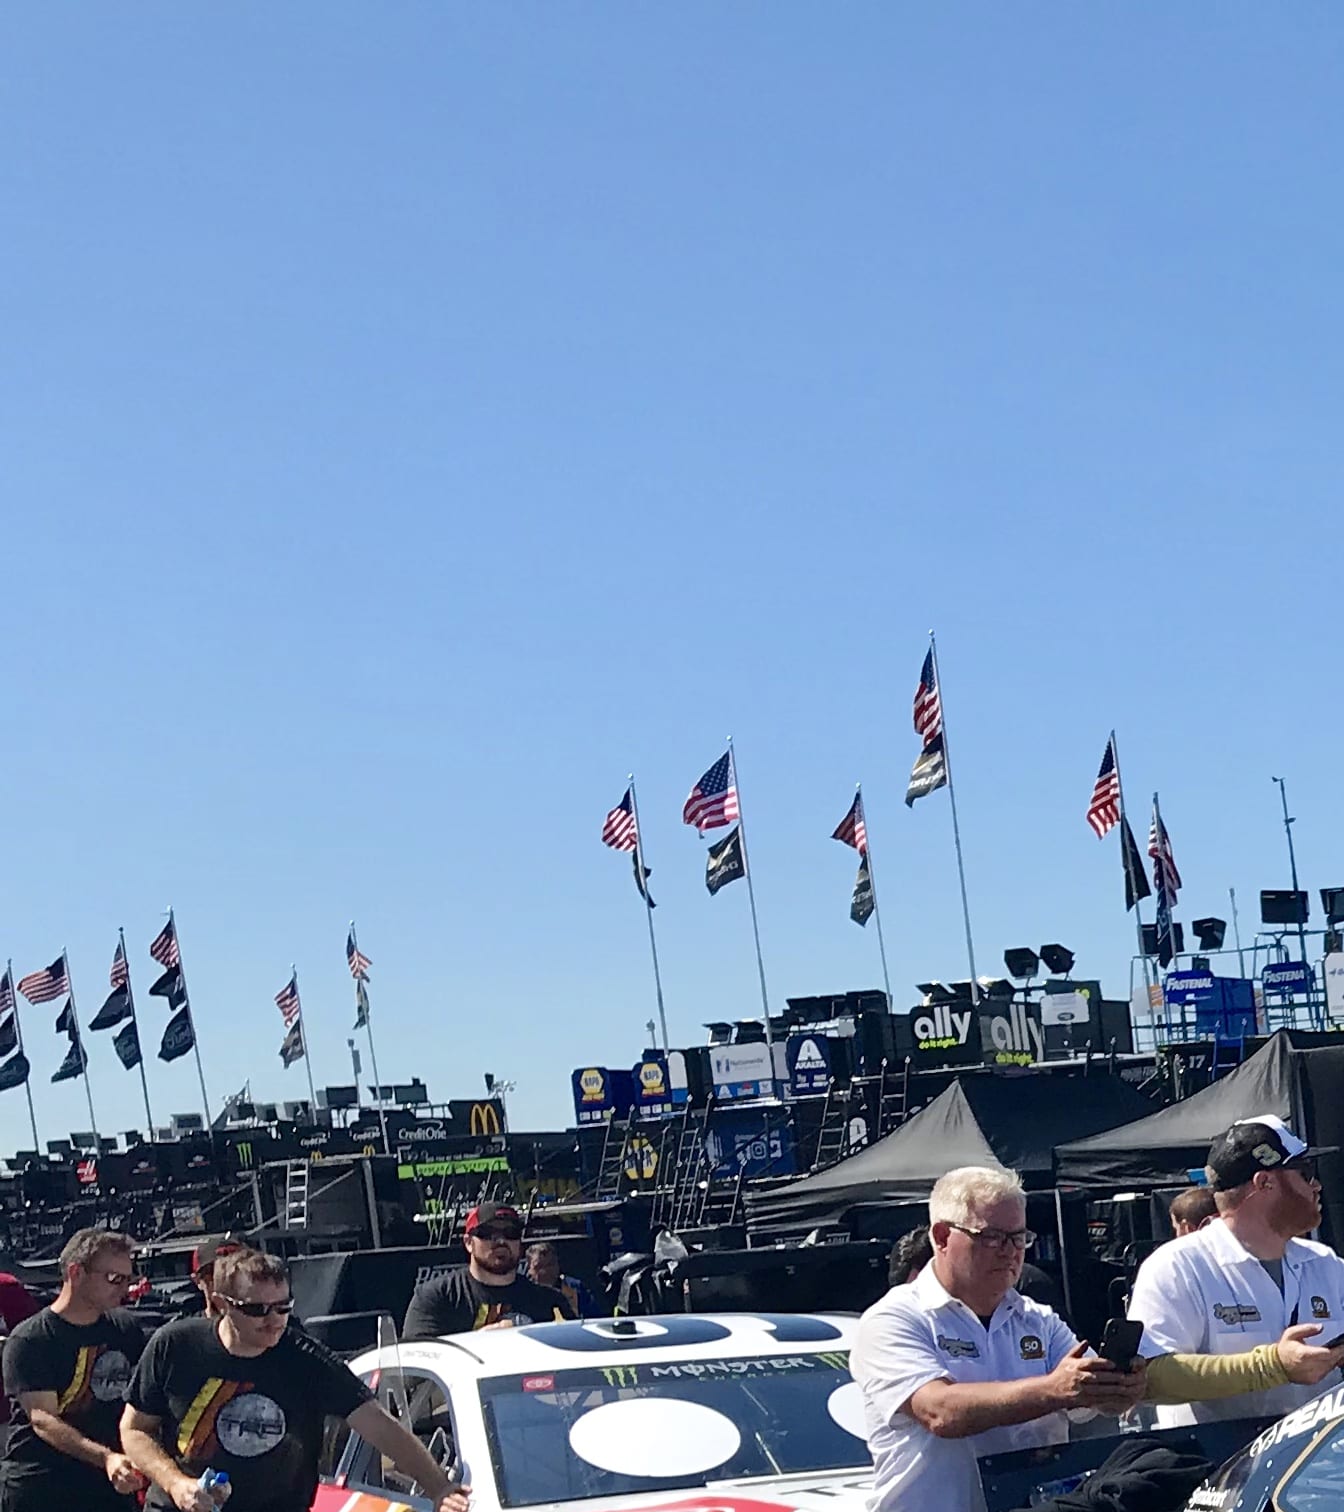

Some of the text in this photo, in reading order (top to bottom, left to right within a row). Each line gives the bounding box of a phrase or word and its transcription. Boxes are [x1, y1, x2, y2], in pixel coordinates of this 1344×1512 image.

[1166, 977, 1214, 992] FASTENAL
[914, 1006, 971, 1044] ally
[990, 1004, 1044, 1064] ally
[795, 1060, 826, 1070] AXALTA
[1188, 1055, 1206, 1069] 17
[1251, 1143, 1281, 1166] 3
